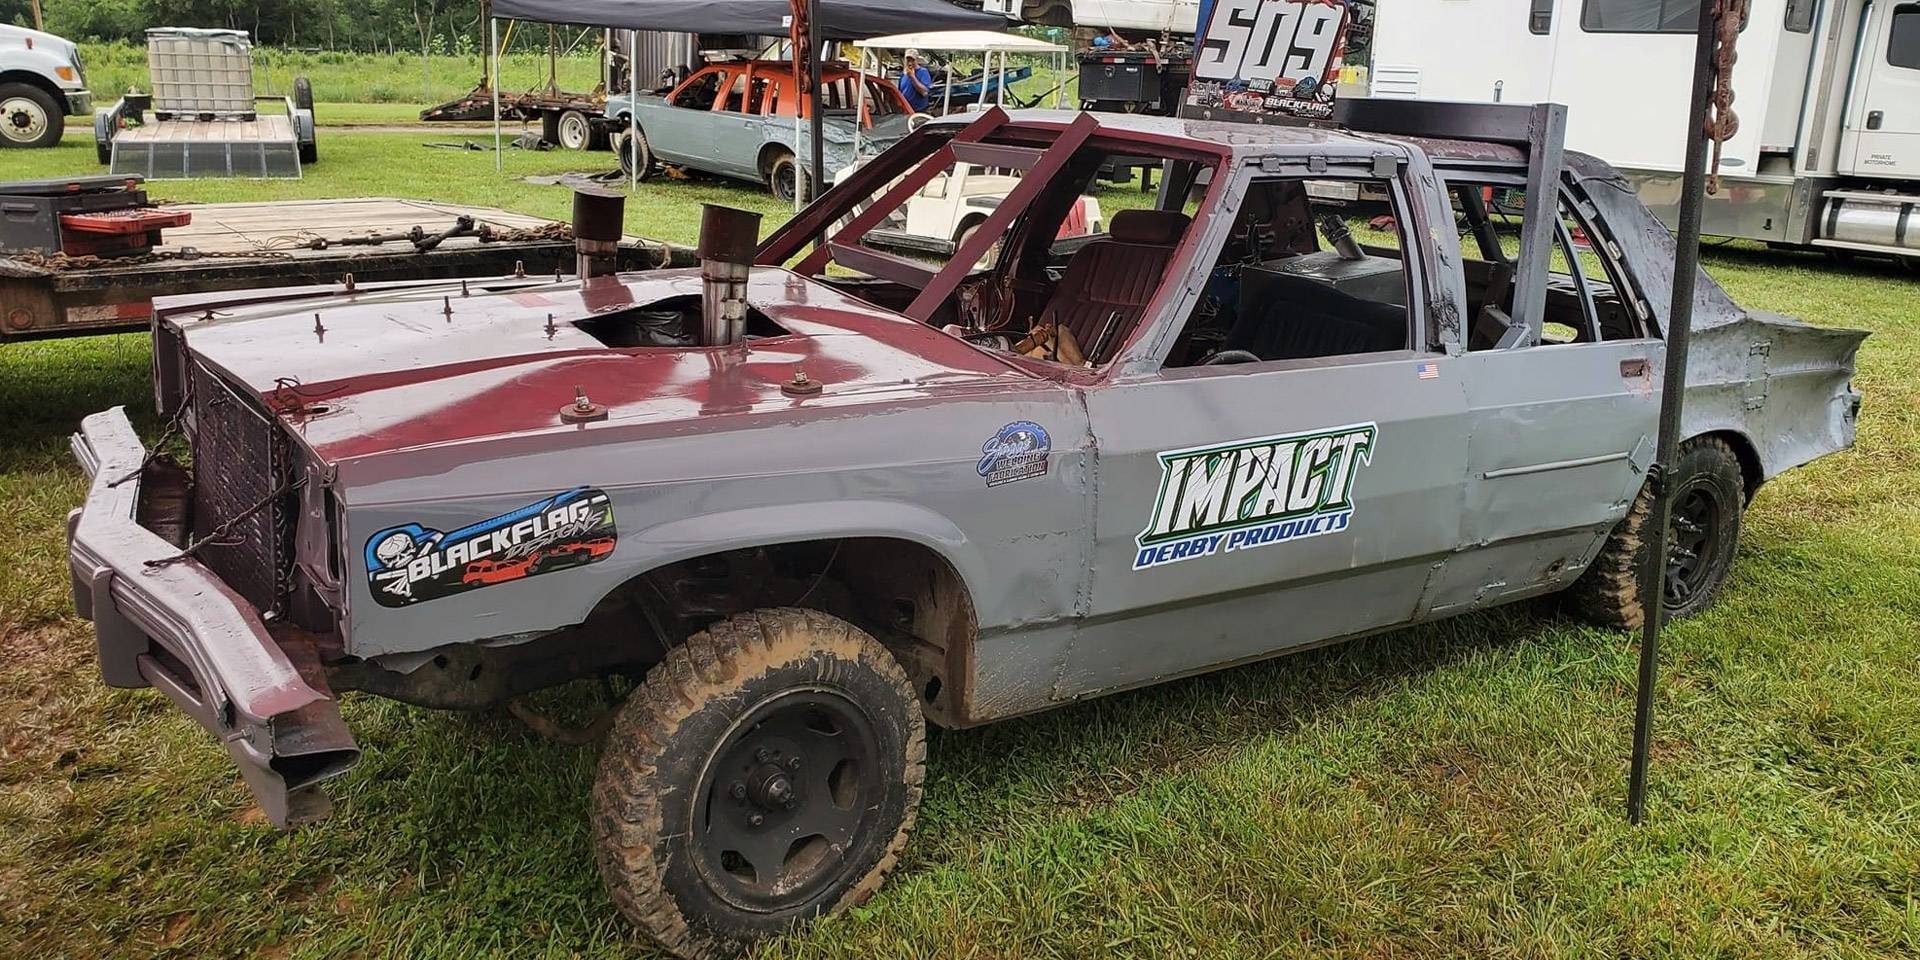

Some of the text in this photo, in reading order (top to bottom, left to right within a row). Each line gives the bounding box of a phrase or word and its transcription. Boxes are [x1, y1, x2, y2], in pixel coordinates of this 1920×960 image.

[1196, 0, 1345, 83] 509
[1264, 97, 1328, 113] BLACKFLAG
[987, 461, 1046, 483] FABRICATION
[1150, 430, 1372, 537] IMPACT
[407, 499, 590, 583] BLACKFLAG
[504, 511, 604, 560] DESIGNS
[1136, 512, 1351, 567] DERBY PRODUCTS
